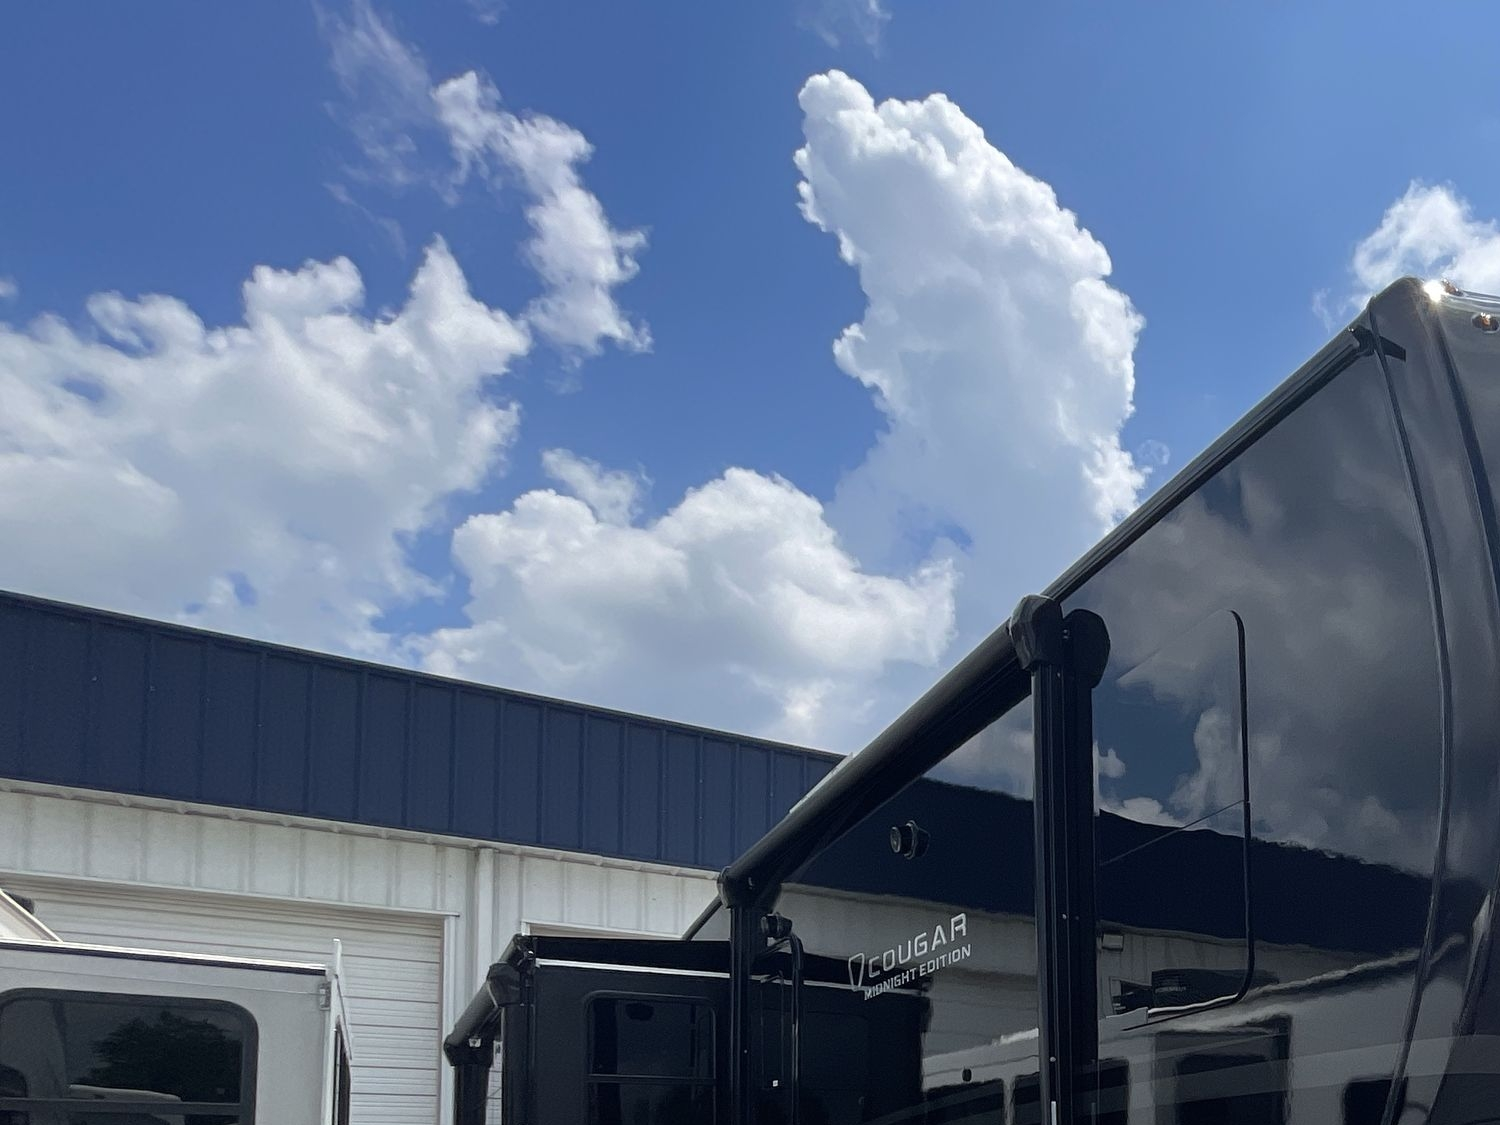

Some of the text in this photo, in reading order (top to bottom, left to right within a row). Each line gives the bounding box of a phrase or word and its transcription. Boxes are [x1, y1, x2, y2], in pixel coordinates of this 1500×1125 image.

[864, 944, 972, 1001] MIDNIGHT EDITION
[868, 912, 967, 978] COUGAR
